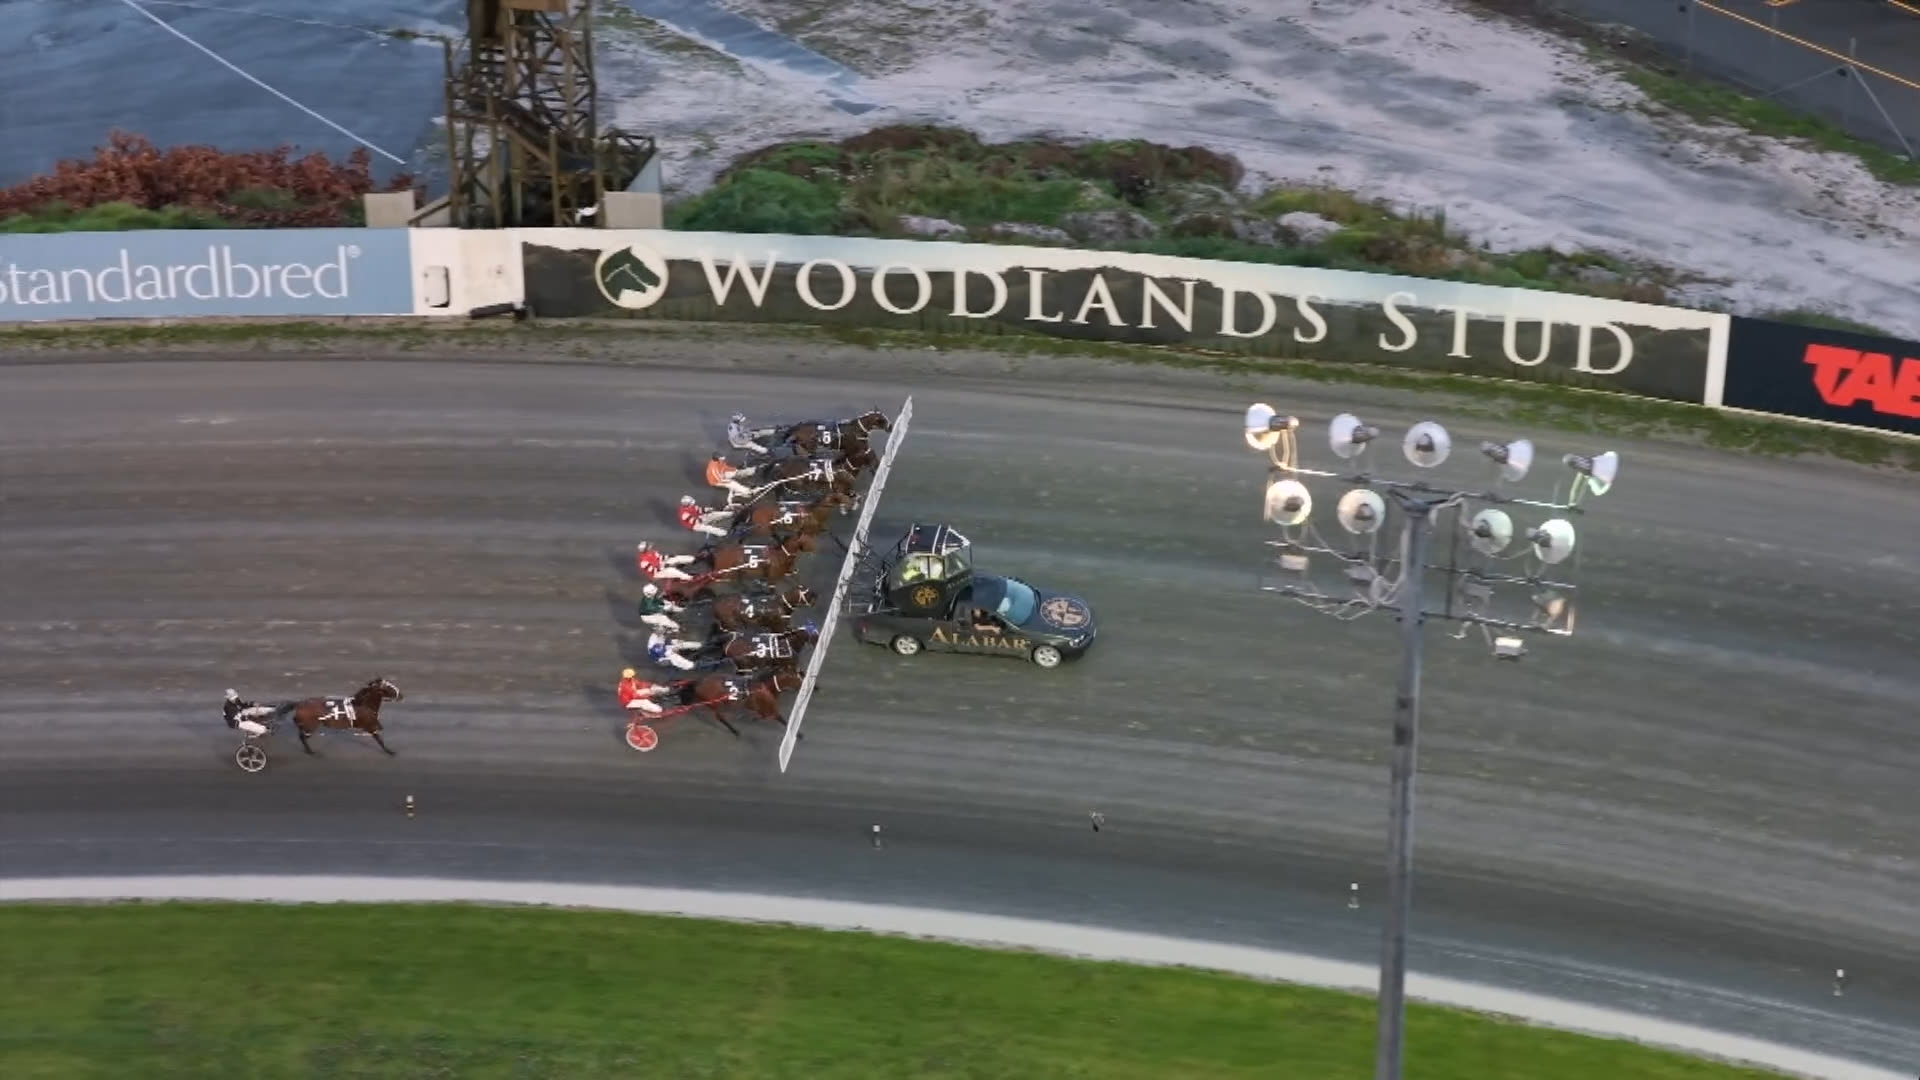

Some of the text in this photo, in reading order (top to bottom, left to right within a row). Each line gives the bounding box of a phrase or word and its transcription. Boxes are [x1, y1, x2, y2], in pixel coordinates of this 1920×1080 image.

[700, 250, 1634, 375] WOODLANDS STUD
[928, 627, 1029, 650] ALABAR
[756, 643, 766, 658] 3
[728, 687, 739, 700] 2
